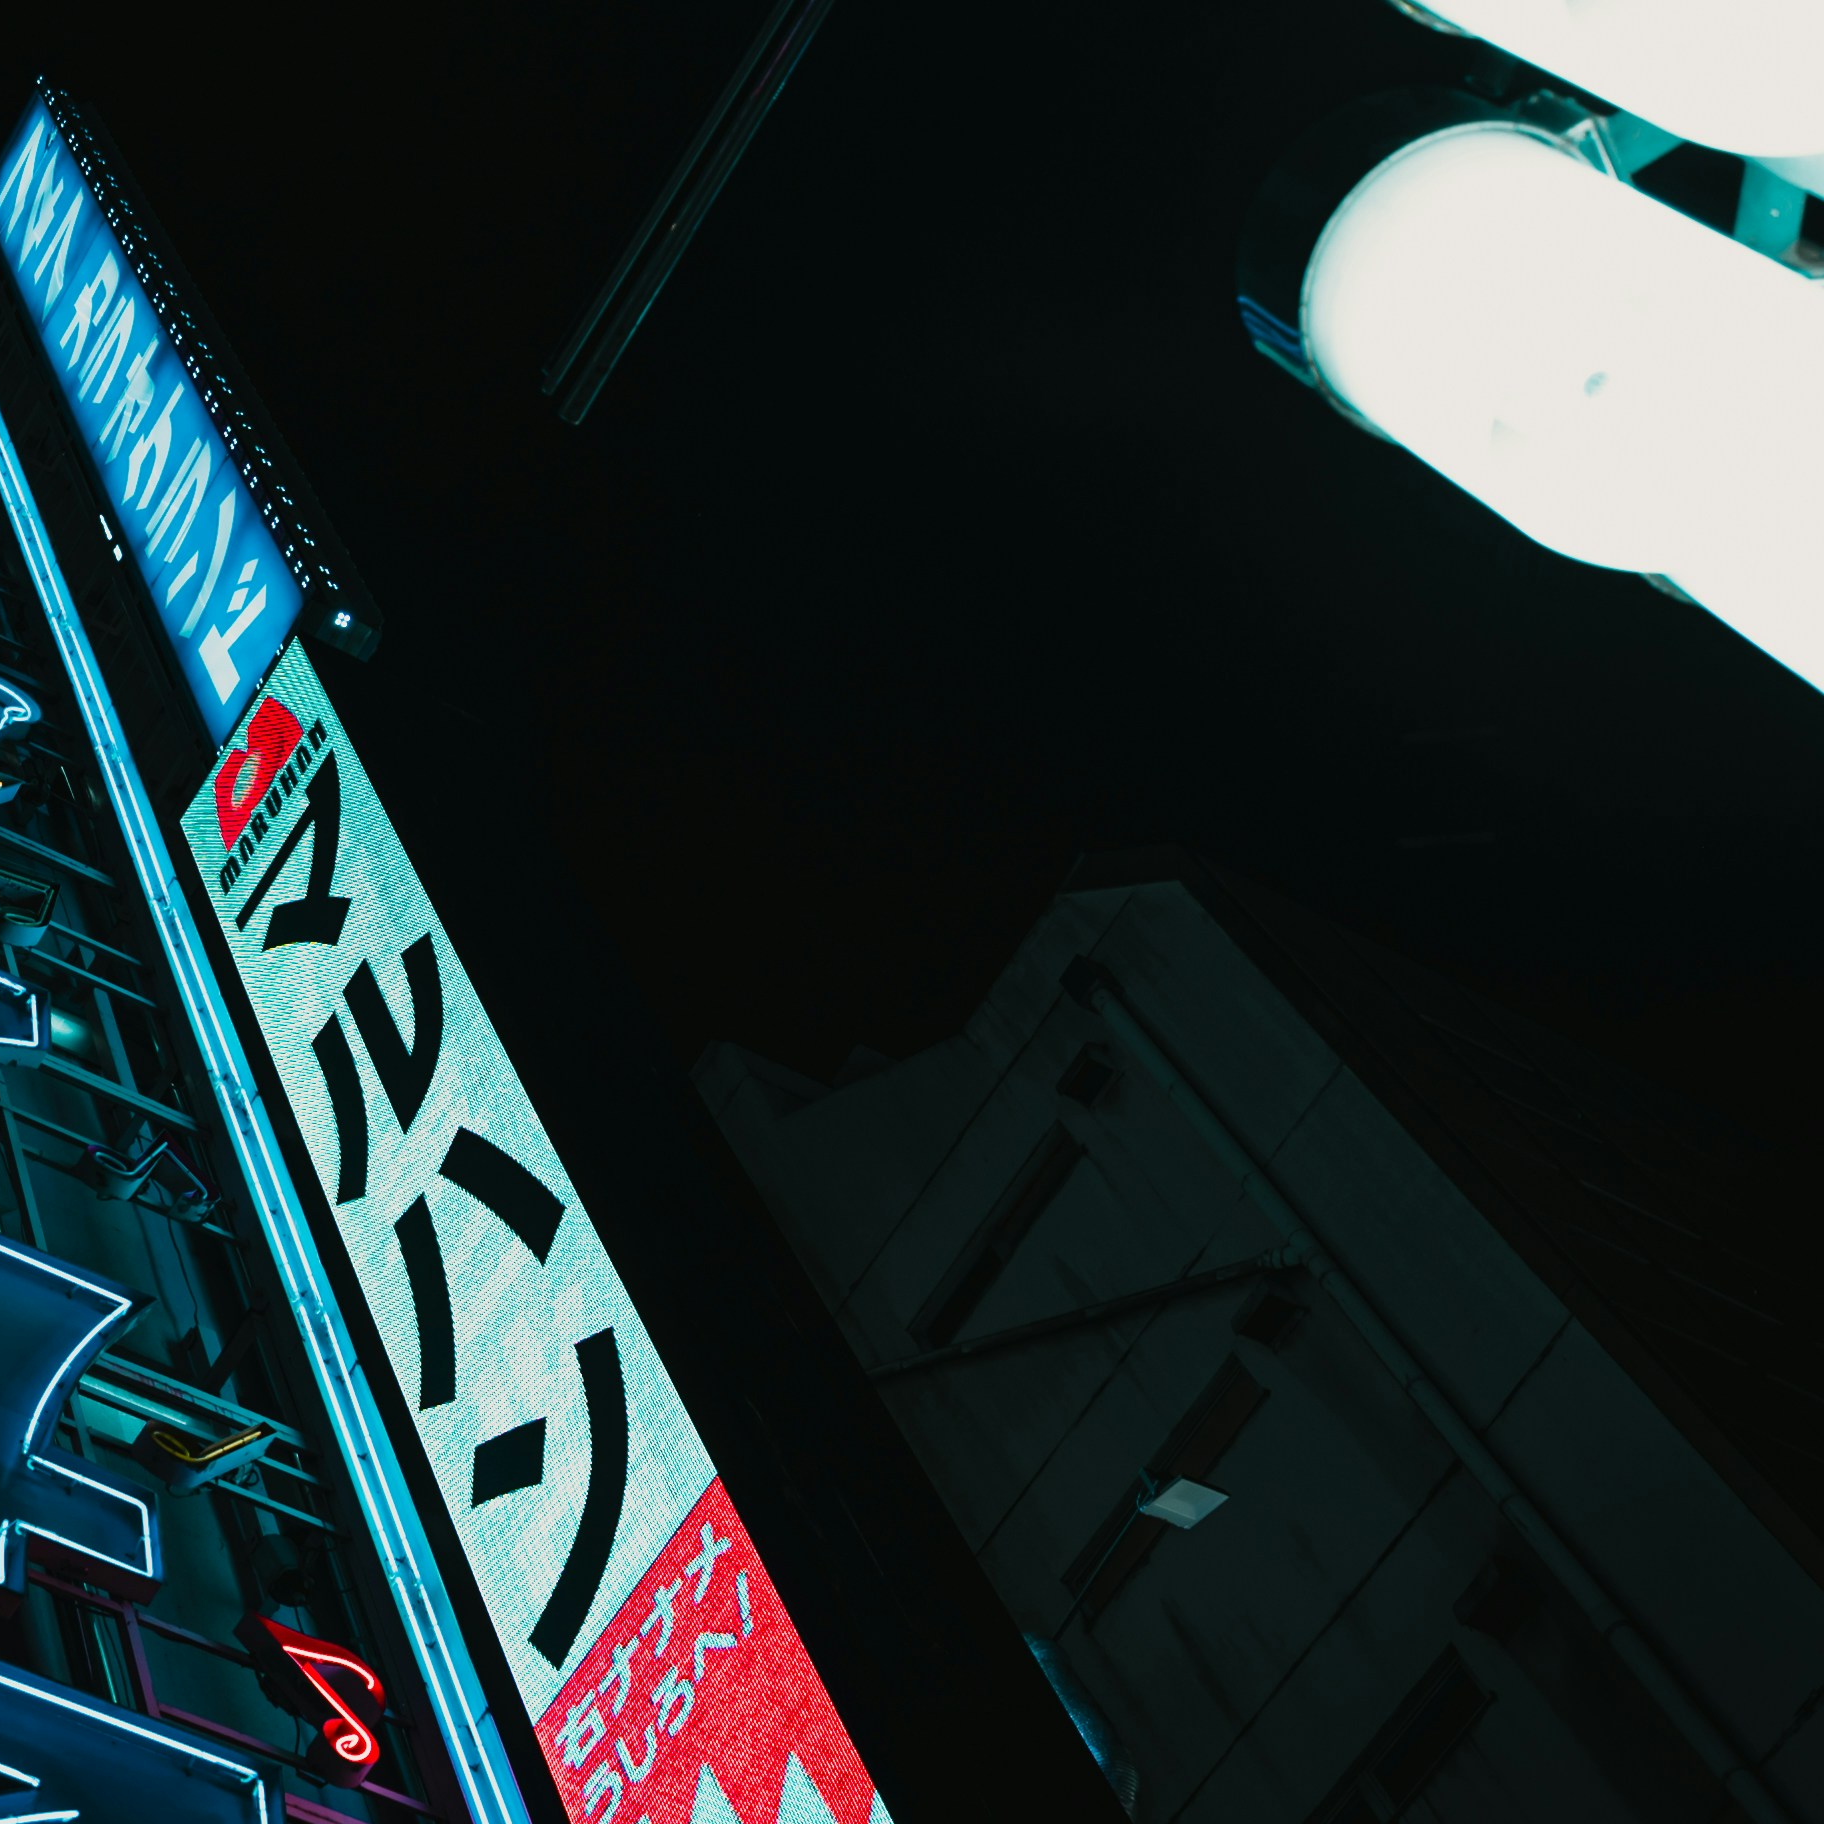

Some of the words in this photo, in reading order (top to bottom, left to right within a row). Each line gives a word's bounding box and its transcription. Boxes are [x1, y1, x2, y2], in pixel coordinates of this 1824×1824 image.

[218, 717, 328, 896] MARUHAN
[235, 747, 630, 1672] マルハン
[554, 1521, 732, 1770] 右ナナメ
